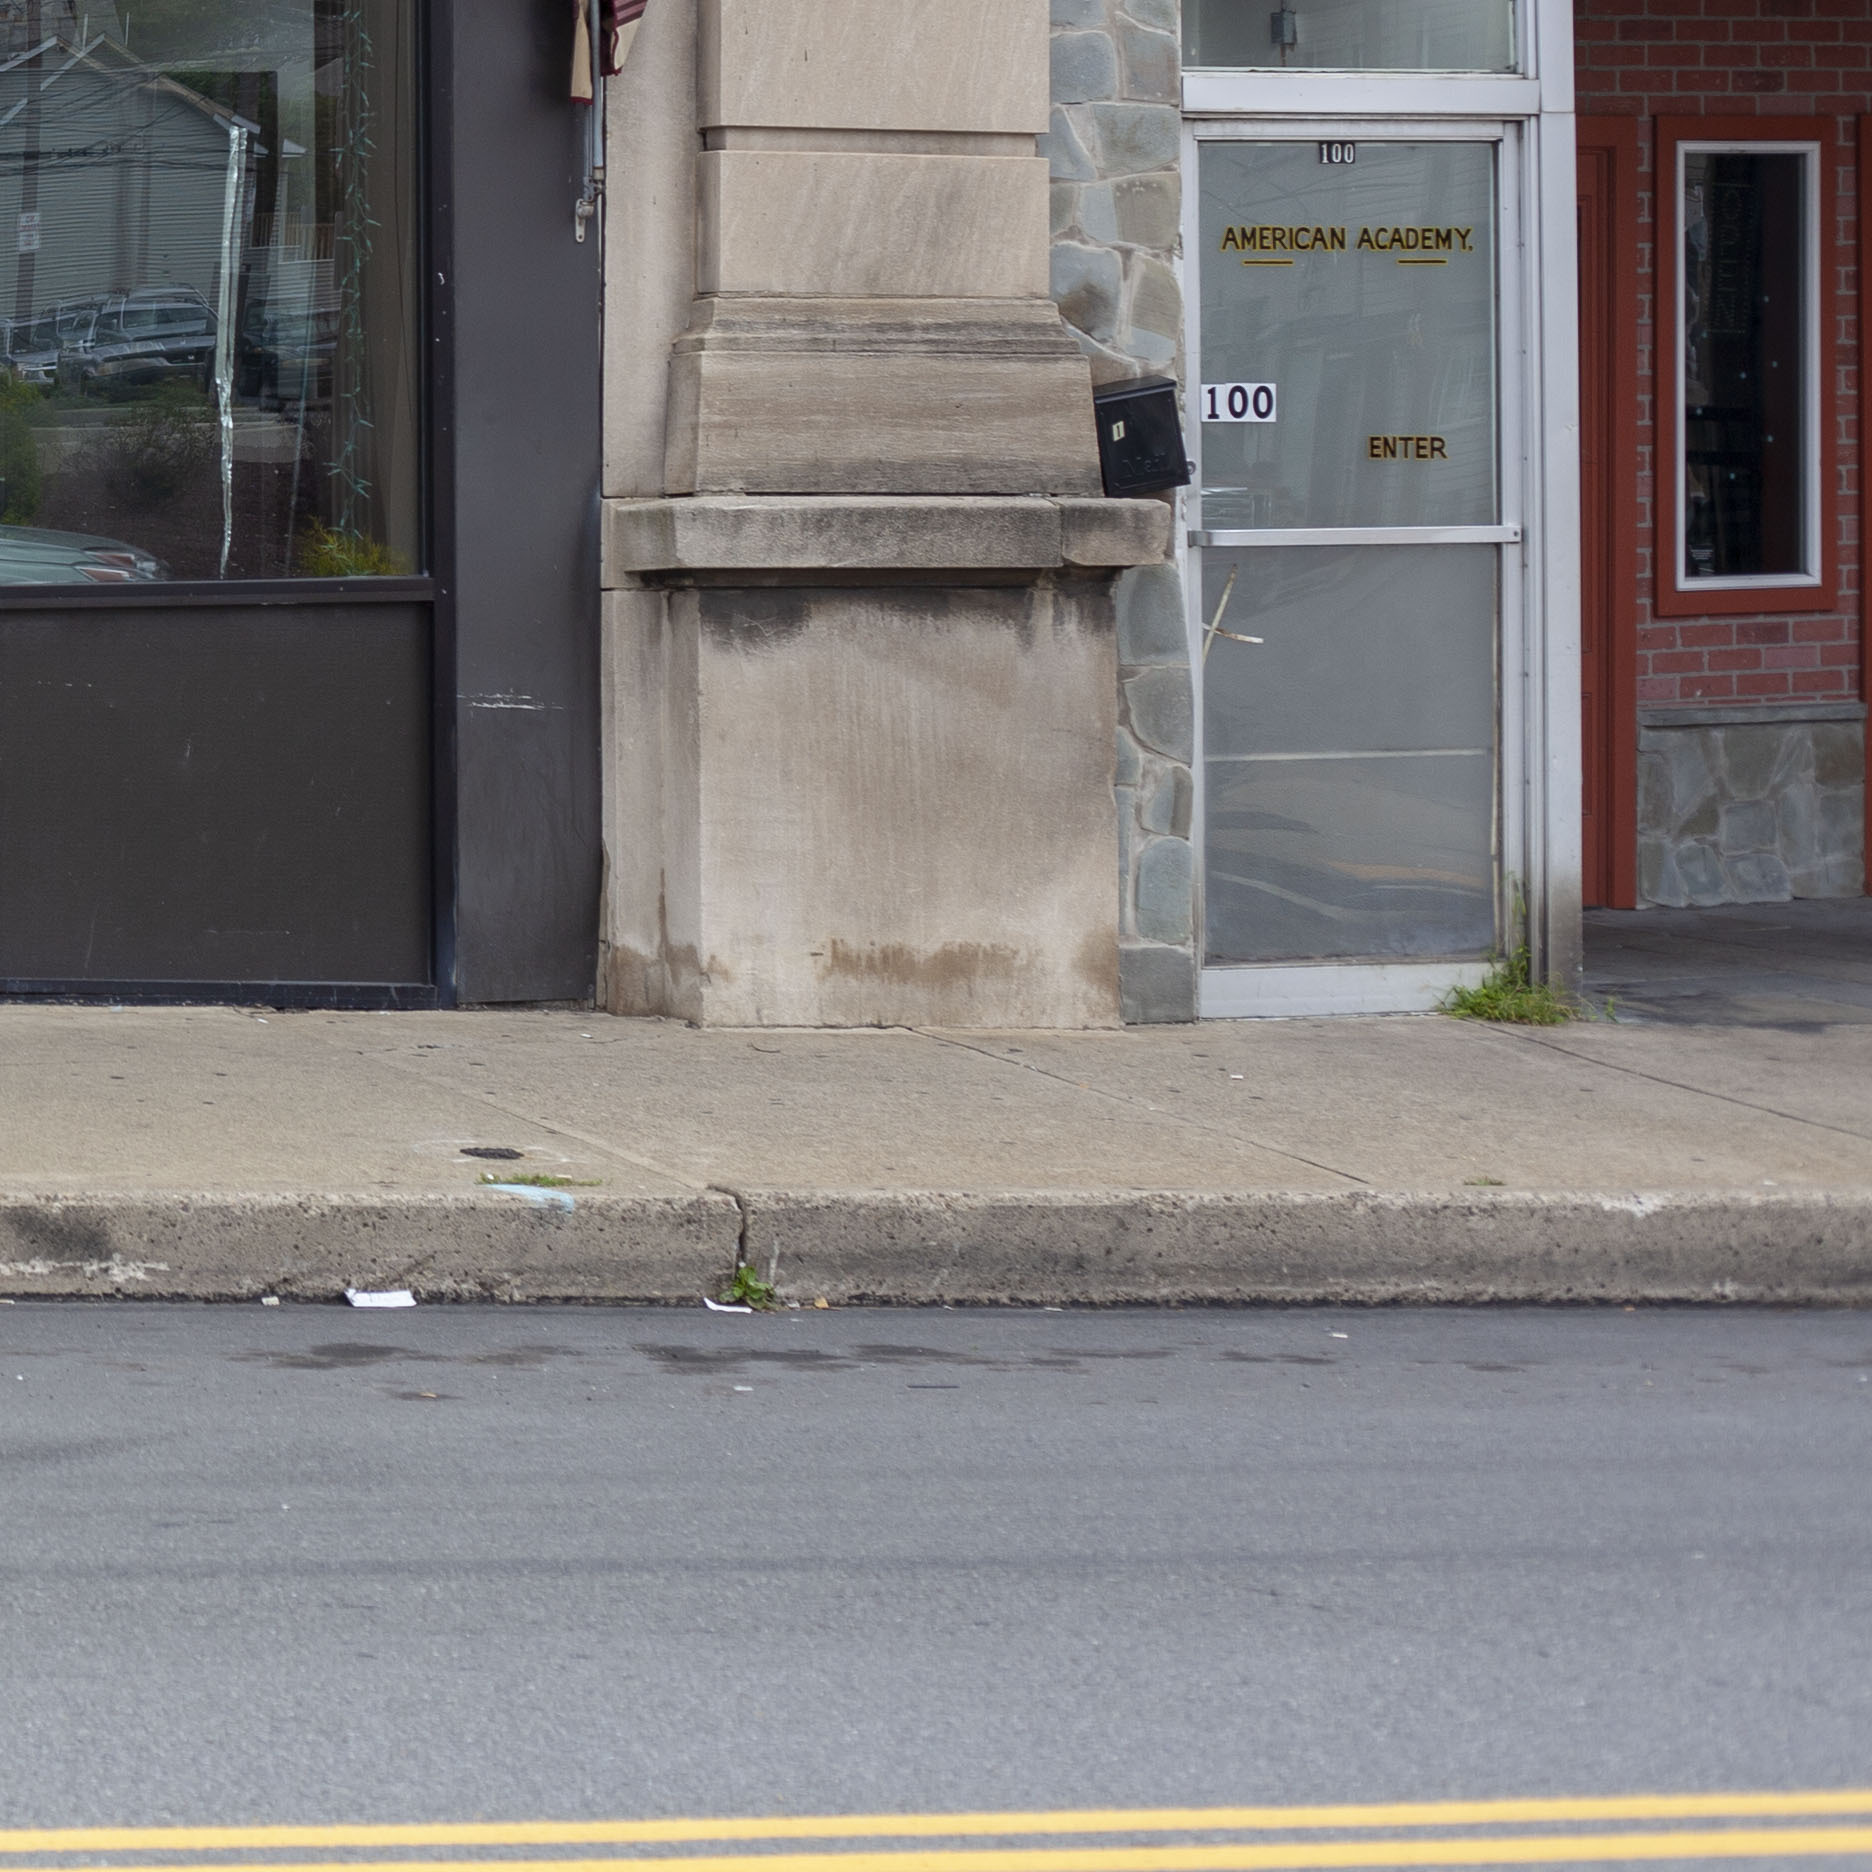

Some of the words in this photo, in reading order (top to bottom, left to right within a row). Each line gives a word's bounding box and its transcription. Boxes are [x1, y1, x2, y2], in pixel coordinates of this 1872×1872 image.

[1321, 143, 1354, 164] 100
[1221, 226, 1346, 251] AMERICAN
[1206, 385, 1274, 420] 100
[1368, 435, 1448, 460] ENTER
